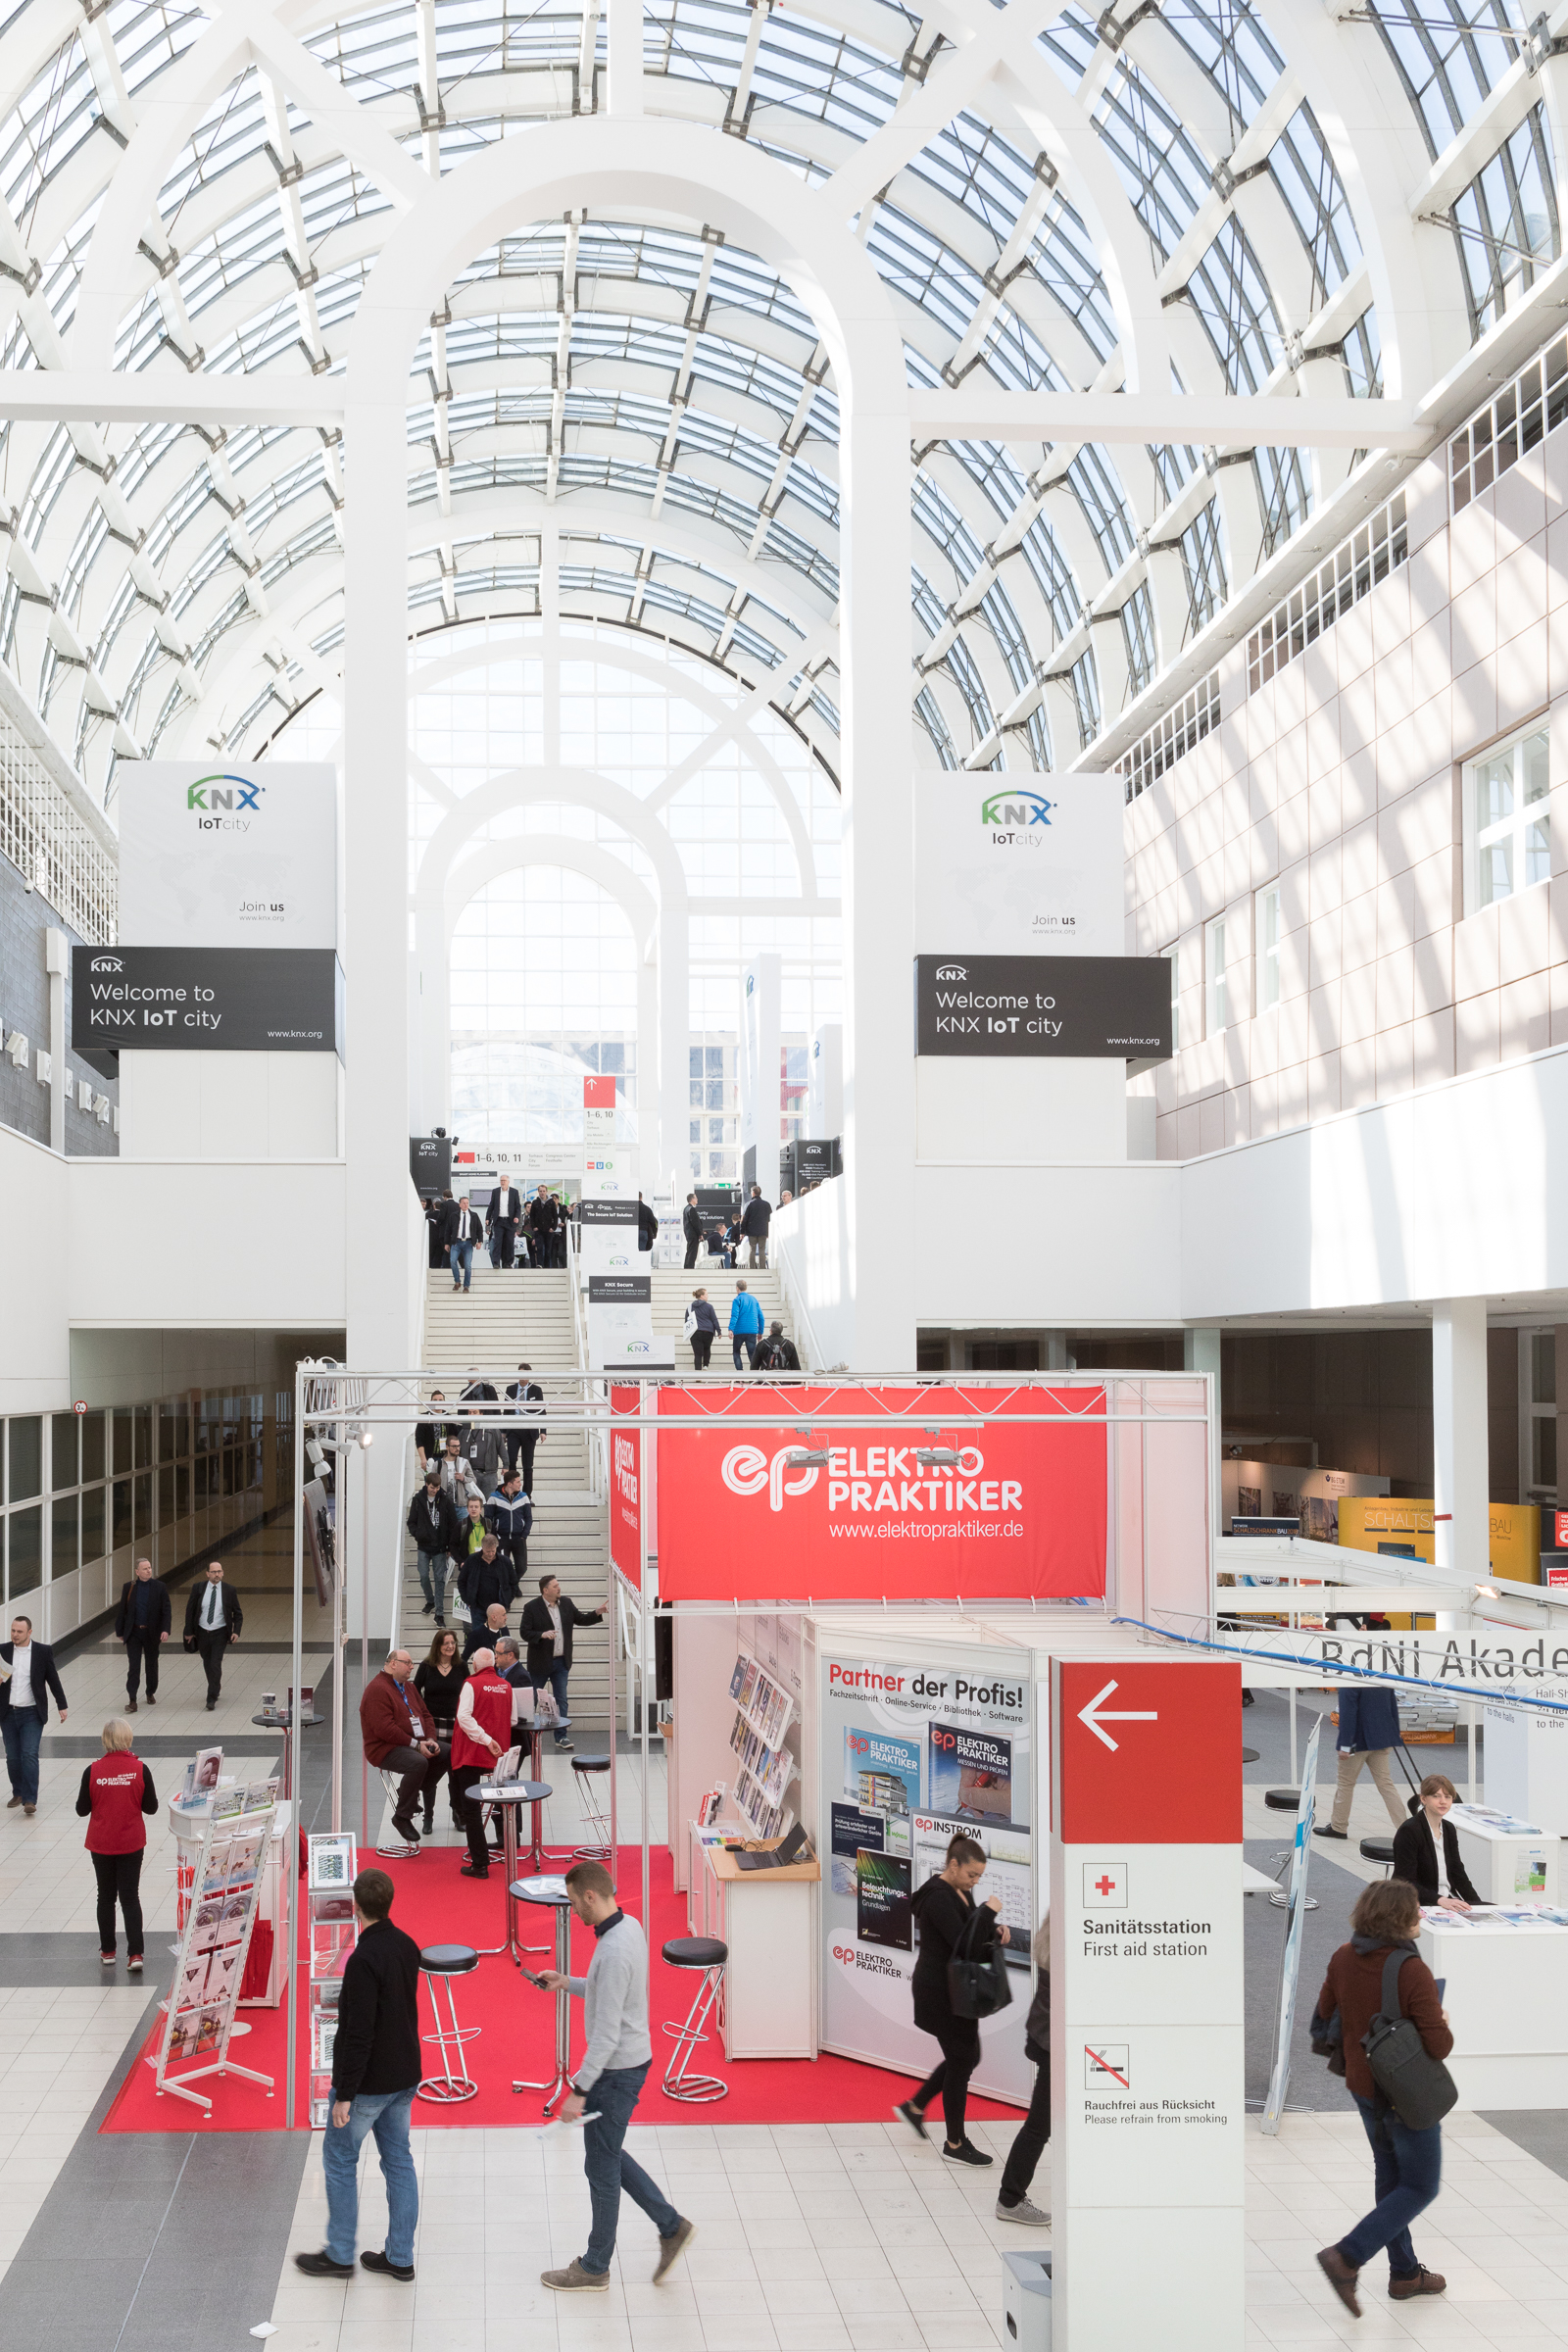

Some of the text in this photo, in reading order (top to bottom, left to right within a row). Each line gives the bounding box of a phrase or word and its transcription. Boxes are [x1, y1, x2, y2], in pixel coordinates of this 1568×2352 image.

[187, 789, 261, 810] KNX
[982, 805, 1053, 825] KNX
[239, 902, 284, 912] Join us
[1032, 914, 1076, 926] Join us
[91, 960, 123, 972] KNX
[936, 969, 967, 981] KNX
[90, 983, 215, 1002] Welcome to
[935, 992, 1055, 1009] Welcome to
[90, 1008, 221, 1029] KNX IoT city
[936, 1016, 1063, 1037] KNX IoT city
[268, 1029, 322, 1040] www.knx.org
[1106, 1036, 1160, 1047] www.knx.org
[497, 1153, 510, 1163] 10,
[513, 1153, 521, 1162] 11
[721, 1445, 985, 1512] ep ELEKTRO
[828, 1481, 1023, 1511] PRAKTIKER
[829, 1520, 1024, 1542] www.elektropraktiker.de
[1490, 1518, 1512, 1534] BAU
[1322, 1639, 1568, 1679] BdNI Akade
[829, 1663, 906, 1692] Partner
[912, 1674, 949, 1698] der
[956, 1680, 1023, 1708] Profis!
[829, 1690, 1023, 1723] Fachzeitschrift Online-Service Bibliothek Software
[1494, 1708, 1502, 1719] the
[1502, 1712, 1515, 1724] halls
[1537, 1719, 1565, 1729] to the
[846, 1735, 908, 1758] ep ELEKTRO
[931, 1730, 999, 1754] ep ELEKTRO
[870, 1749, 918, 1770] PRAKTIKER
[956, 1745, 1008, 1767] PRAKTIKER
[957, 1758, 1008, 1776] MESSEN UND PRÜFEN
[834, 1818, 850, 1827] Prüfung
[915, 1818, 933, 1833] ep
[861, 1882, 907, 1898] Beleuchtungs-
[861, 1890, 885, 1901] technik
[862, 1899, 891, 1912] Grundlagen
[1083, 1919, 1211, 1935] Sanitätsstation
[832, 1945, 893, 1967] ep ELEKTRO
[1084, 1941, 1207, 1956] First aid station
[856, 1960, 902, 1979] PRAKTIKER
[1084, 2100, 1136, 2110] Rauchfrei
[1162, 2099, 1215, 2110] Rücksicht
[1085, 2114, 1228, 2126] Please refrain from smoking
